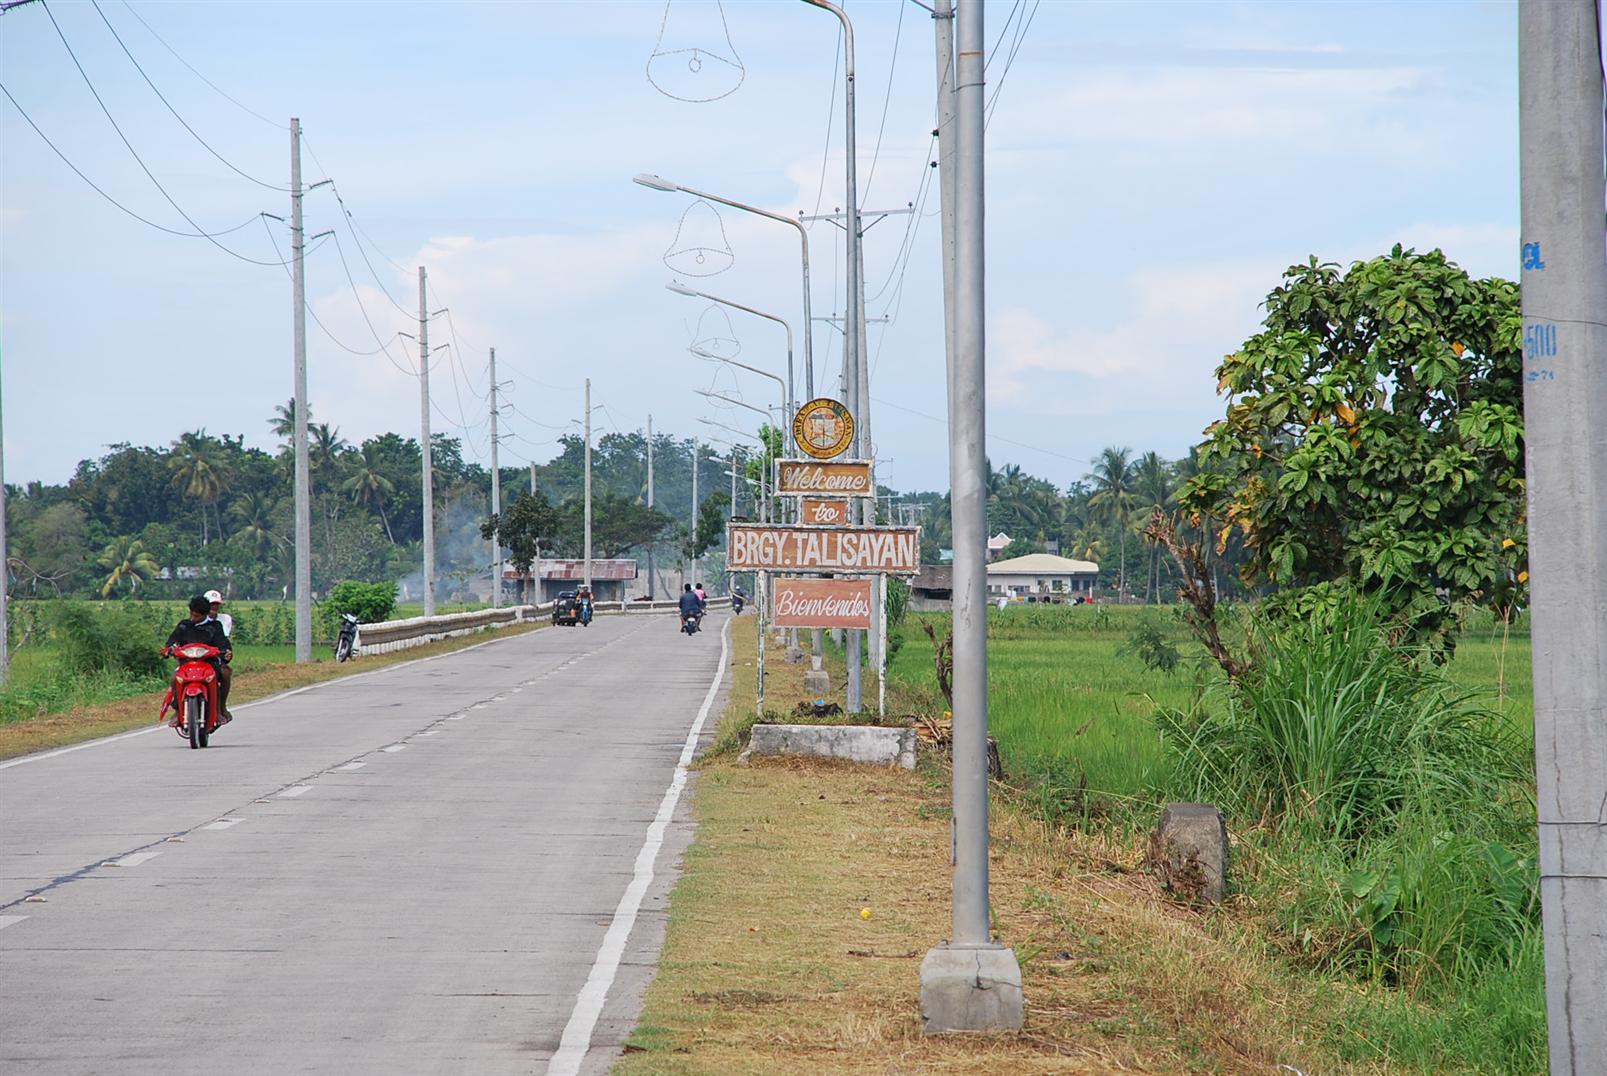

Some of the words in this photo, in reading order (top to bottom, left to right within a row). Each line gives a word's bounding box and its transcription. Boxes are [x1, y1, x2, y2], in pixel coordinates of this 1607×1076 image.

[783, 466, 867, 490] Welcome
[732, 531, 791, 565] BRGY.
[792, 532, 914, 567] TALISAYAN
[776, 588, 870, 617] Bienvenidos
